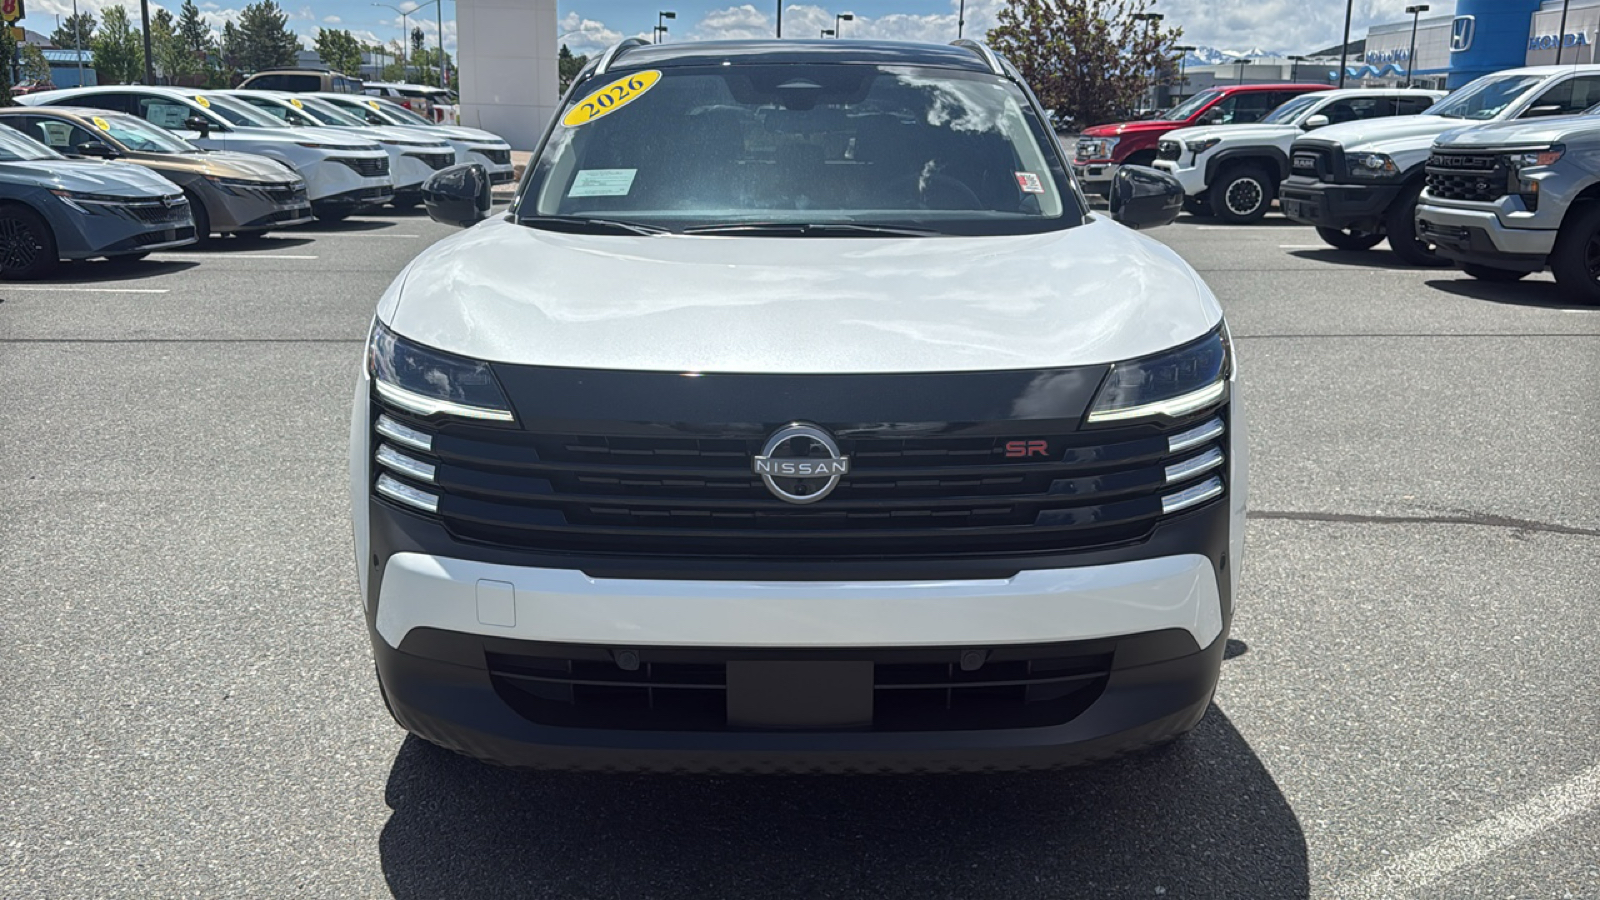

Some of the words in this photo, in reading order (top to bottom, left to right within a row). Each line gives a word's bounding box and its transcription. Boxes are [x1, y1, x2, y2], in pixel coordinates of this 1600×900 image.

[1529, 32, 1587, 50] HONDA
[580, 76, 644, 120] 2026
[1005, 440, 1049, 457] SR
[756, 460, 846, 475] NISSAN
